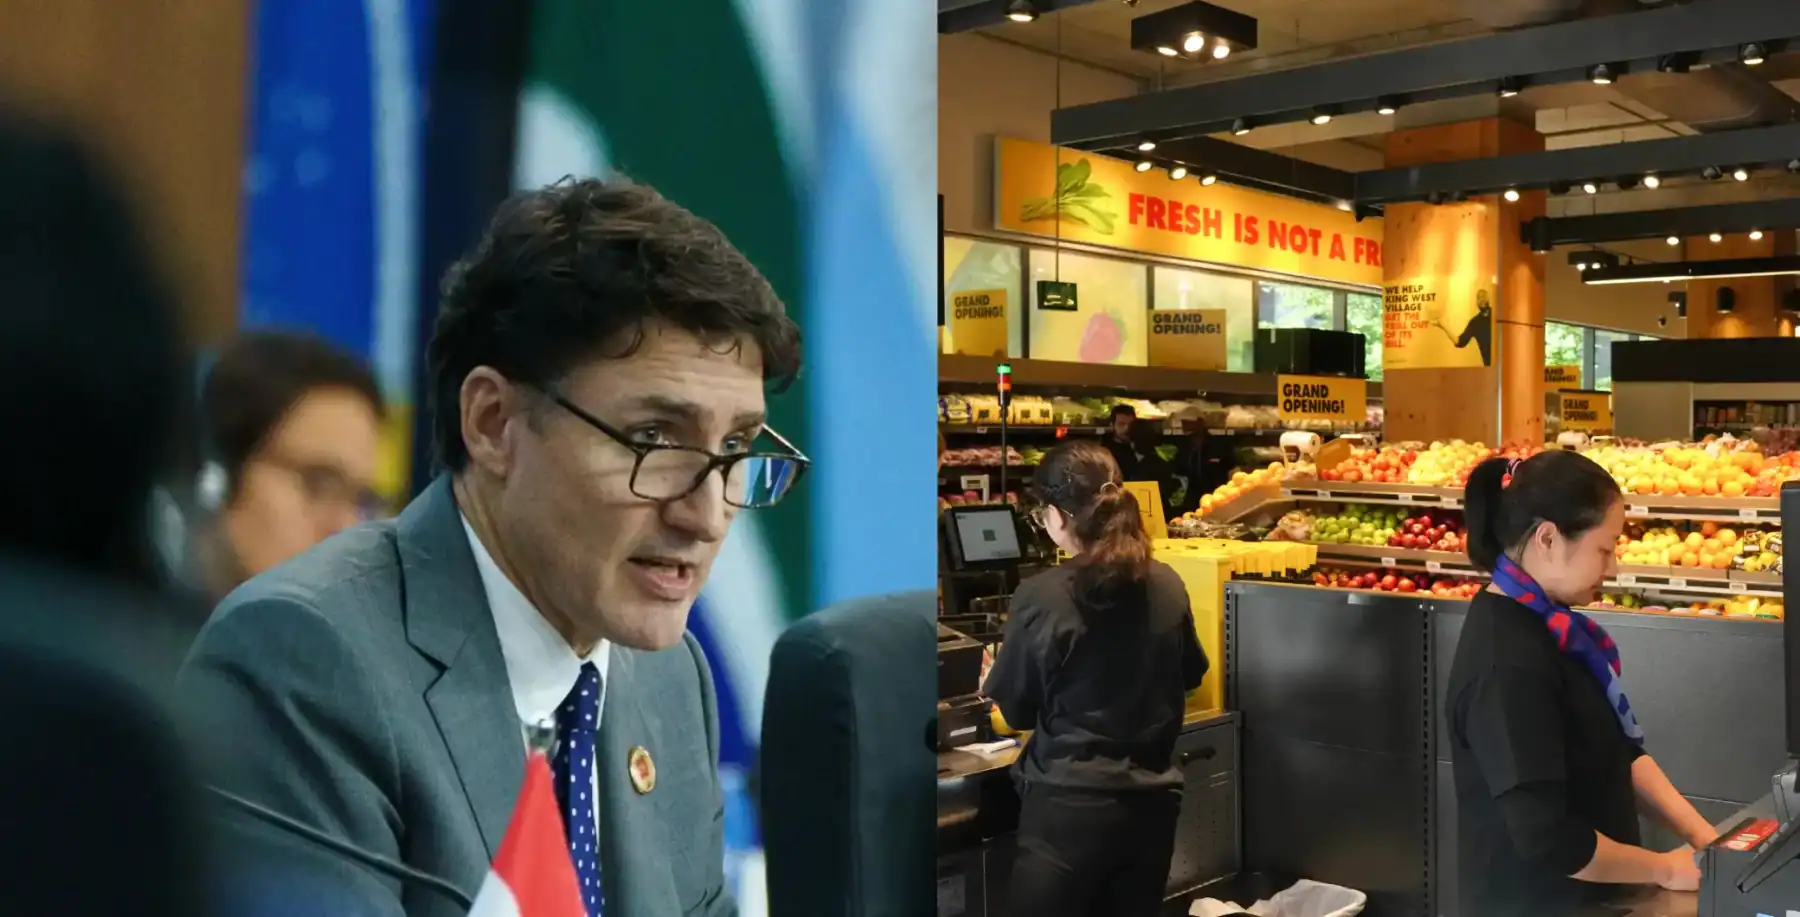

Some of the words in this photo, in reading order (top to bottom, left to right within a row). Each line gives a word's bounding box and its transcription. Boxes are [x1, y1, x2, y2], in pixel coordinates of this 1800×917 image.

[1128, 192, 1223, 240] FRESH
[1234, 212, 1259, 246] IS
[1268, 219, 1323, 255] NOT
[1328, 233, 1347, 262] A
[1384, 286, 1399, 295] WE
[1402, 284, 1424, 293] HELP
[1384, 294, 1409, 304] KING
[1411, 292, 1437, 302] WEST
[1384, 302, 1422, 312] VILLAGE
[1152, 313, 1203, 324] GRAND
[1410, 320, 1430, 329] OUT
[1152, 323, 1223, 335] OPENING!
[1282, 383, 1330, 399] GRAND
[1282, 398, 1346, 415] OPENING!
